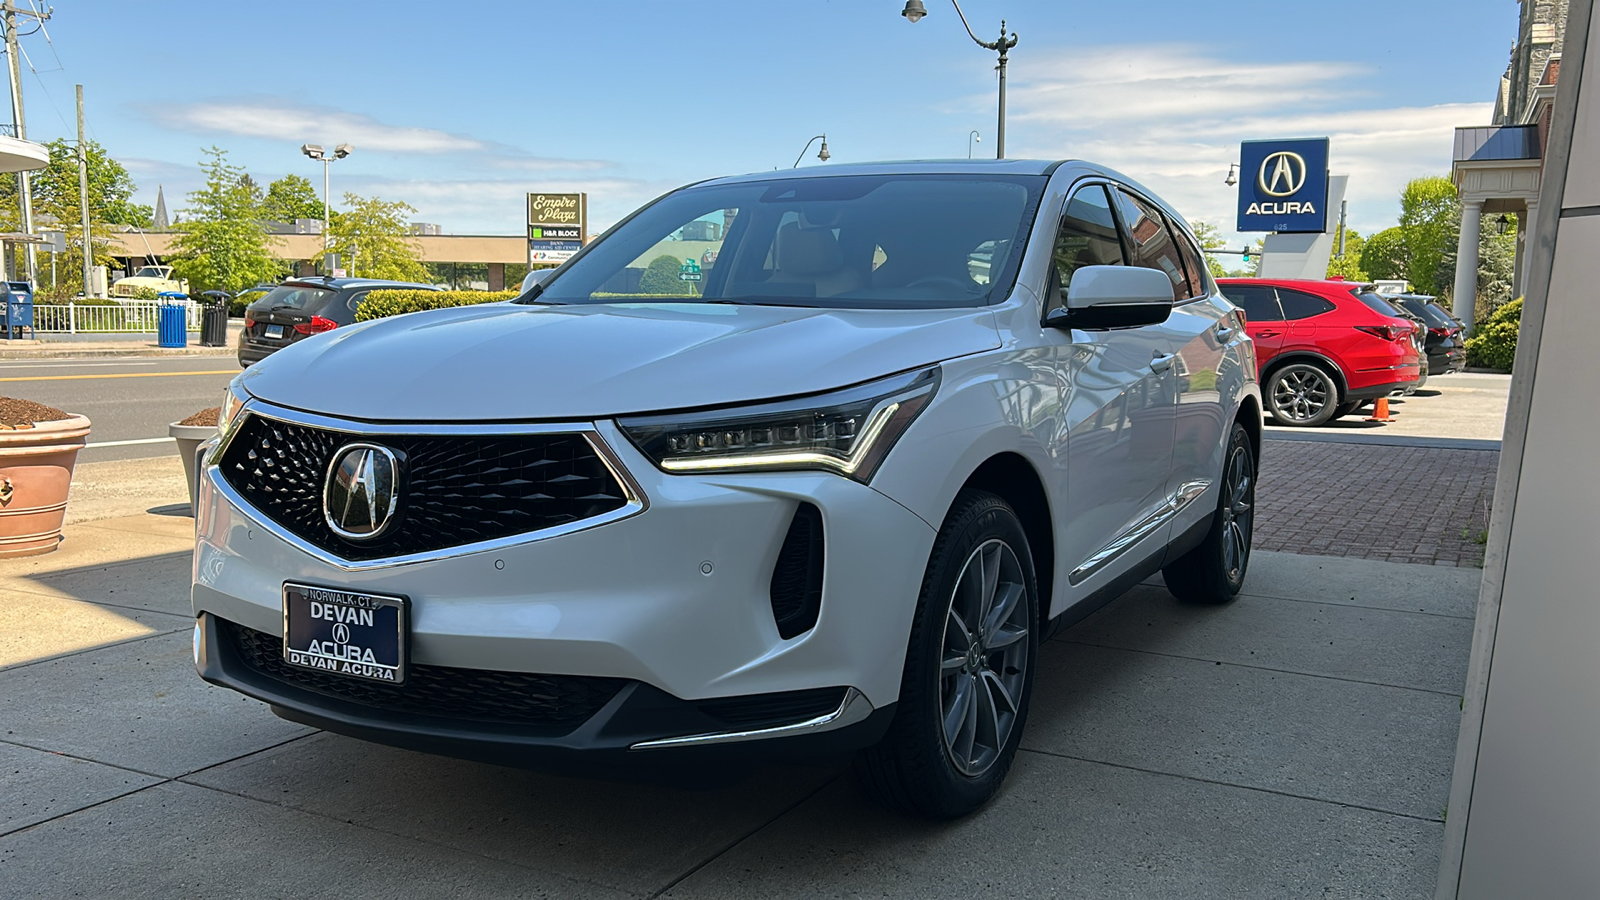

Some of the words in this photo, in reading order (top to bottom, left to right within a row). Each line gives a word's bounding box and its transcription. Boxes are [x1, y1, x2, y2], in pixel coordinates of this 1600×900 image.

[533, 195, 576, 210] Empire
[1245, 202, 1316, 215] ACURA
[538, 207, 576, 223] Plaza
[1273, 223, 1288, 231] 625
[309, 589, 357, 605] NORWALK,
[358, 596, 371, 607] CT
[310, 601, 374, 627] DEVAN
[307, 639, 377, 664] ACURA
[290, 652, 337, 671] DEVAN
[341, 663, 394, 680] ACURA
